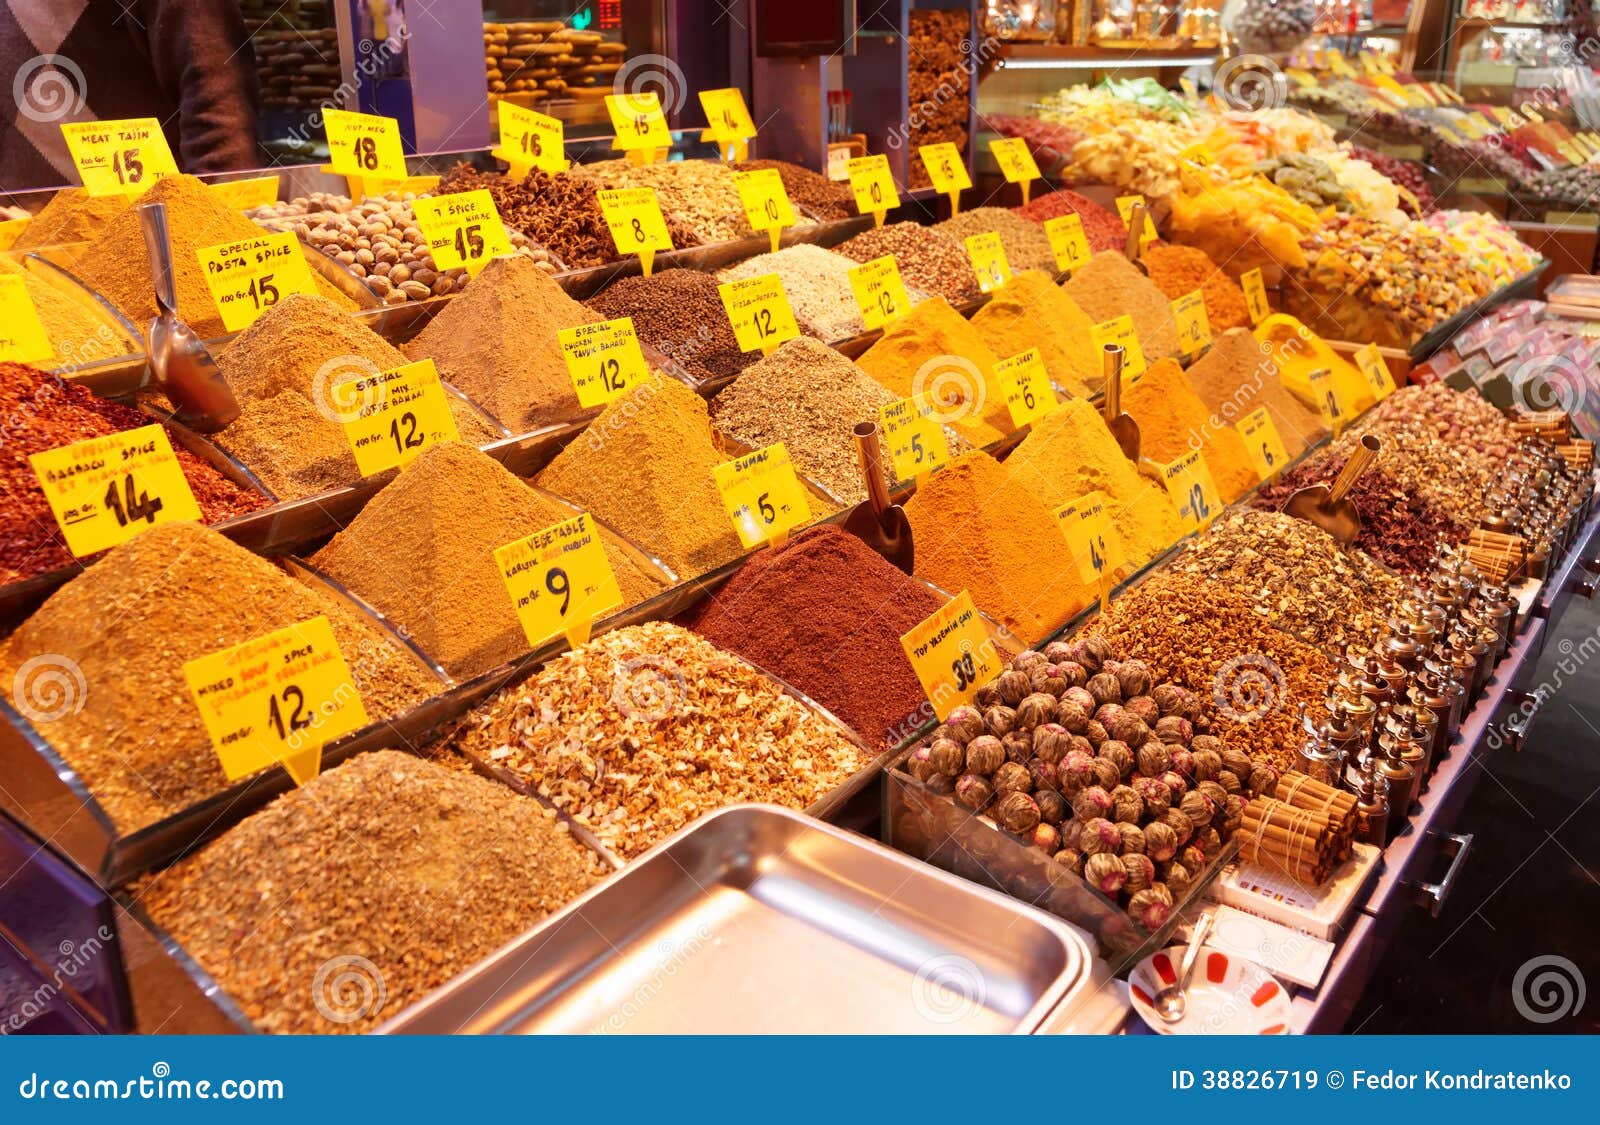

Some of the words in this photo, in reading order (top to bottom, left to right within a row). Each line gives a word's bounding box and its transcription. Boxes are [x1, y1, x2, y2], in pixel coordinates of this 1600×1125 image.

[81, 131, 110, 144] MEAT
[520, 131, 542, 157] 16
[112, 148, 144, 185] 15
[352, 136, 379, 172] 18
[448, 202, 477, 216] SPICE
[764, 198, 779, 221] 10
[454, 224, 485, 262] 15
[631, 217, 646, 244] 8
[207, 256, 248, 273] PASTA
[256, 244, 292, 263] SPICE
[219, 239, 270, 258] SPECIAL
[1066, 240, 1079, 263] 12
[220, 294, 235, 305] 100
[248, 273, 281, 310] 15
[877, 290, 895, 317] 12
[575, 324, 612, 338] SPECIAL
[613, 329, 633, 339] SPICE
[753, 307, 777, 340] 12
[356, 372, 403, 392] SPECIAL
[599, 358, 626, 393] 12
[1022, 384, 1035, 410] 6
[354, 437, 368, 449] 100
[388, 412, 425, 455] 12
[911, 432, 924, 464] 5
[121, 441, 156, 461] SPICE
[734, 449, 769, 472] SUMAC
[1262, 442, 1275, 467] 6
[102, 472, 164, 528] 14
[757, 492, 775, 524] 5
[1189, 483, 1209, 523] 12
[527, 517, 586, 554] VEGETABLE
[517, 595, 530, 609] 100
[545, 566, 569, 616] 9
[914, 645, 928, 660] TOP
[197, 678, 234, 696] MIXED
[283, 646, 314, 662] SPICE
[952, 651, 976, 693] 30
[266, 684, 314, 741] 12
